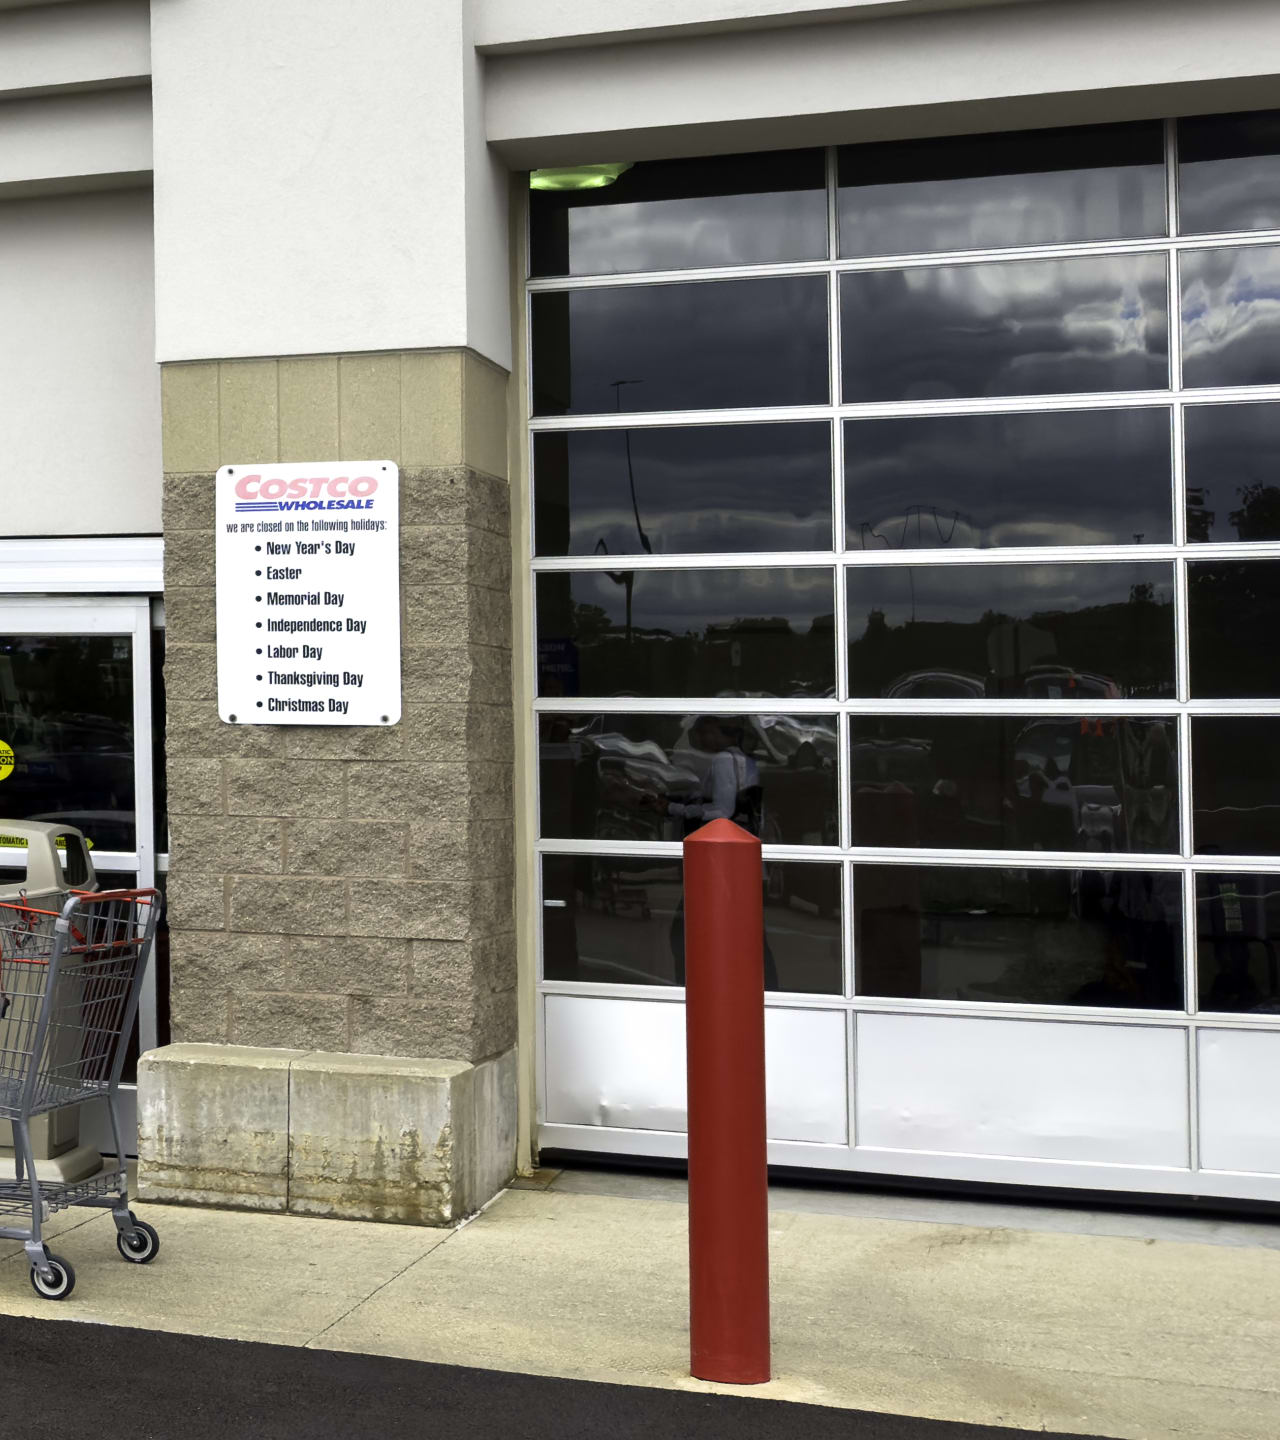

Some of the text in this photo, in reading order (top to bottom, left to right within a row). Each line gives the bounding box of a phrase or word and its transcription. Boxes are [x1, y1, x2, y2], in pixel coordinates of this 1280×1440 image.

[235, 474, 379, 500] COSTCO
[277, 499, 374, 511] WHOLESALE
[226, 519, 387, 533] we are closed on the following holidays:
[266, 541, 355, 556] New Year's Day
[266, 567, 302, 580] Easter
[267, 592, 344, 607] Memorial Day
[267, 618, 367, 634] Independence Day
[267, 645, 323, 660] Labor Day
[268, 671, 363, 687] Thanksgiving Day
[268, 698, 349, 714] Christmas Day
